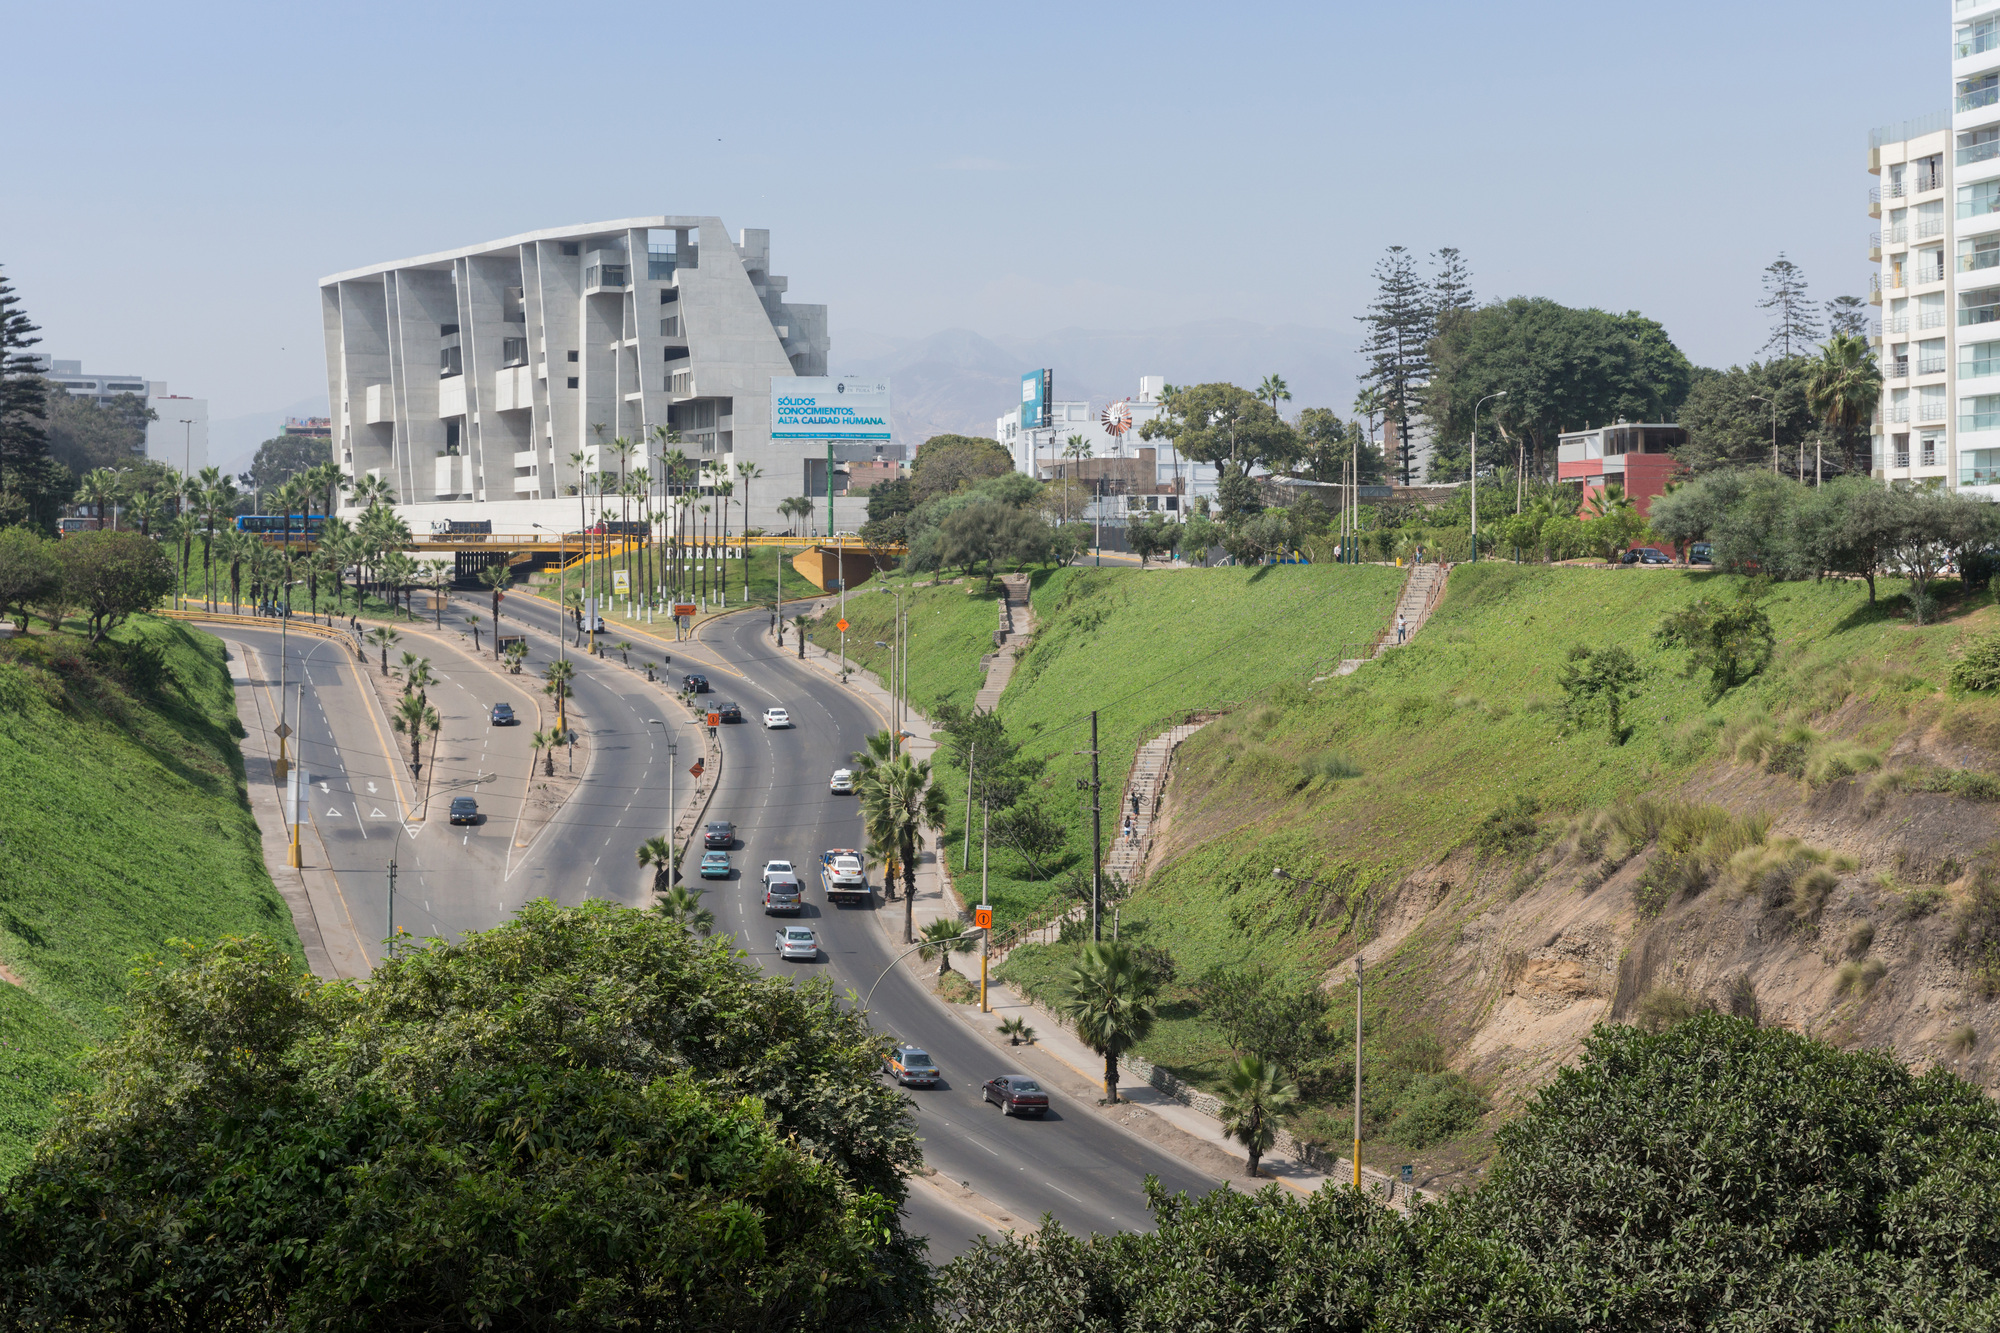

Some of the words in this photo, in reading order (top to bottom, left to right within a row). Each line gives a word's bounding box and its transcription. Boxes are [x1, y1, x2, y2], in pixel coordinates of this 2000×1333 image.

[777, 396, 816, 406] SÓLIDOS
[777, 407, 856, 416] CONOCIMIENTOS,
[777, 416, 800, 425] ALTA
[801, 416, 841, 425] CALIDAD
[842, 417, 886, 425] HUMANA.
